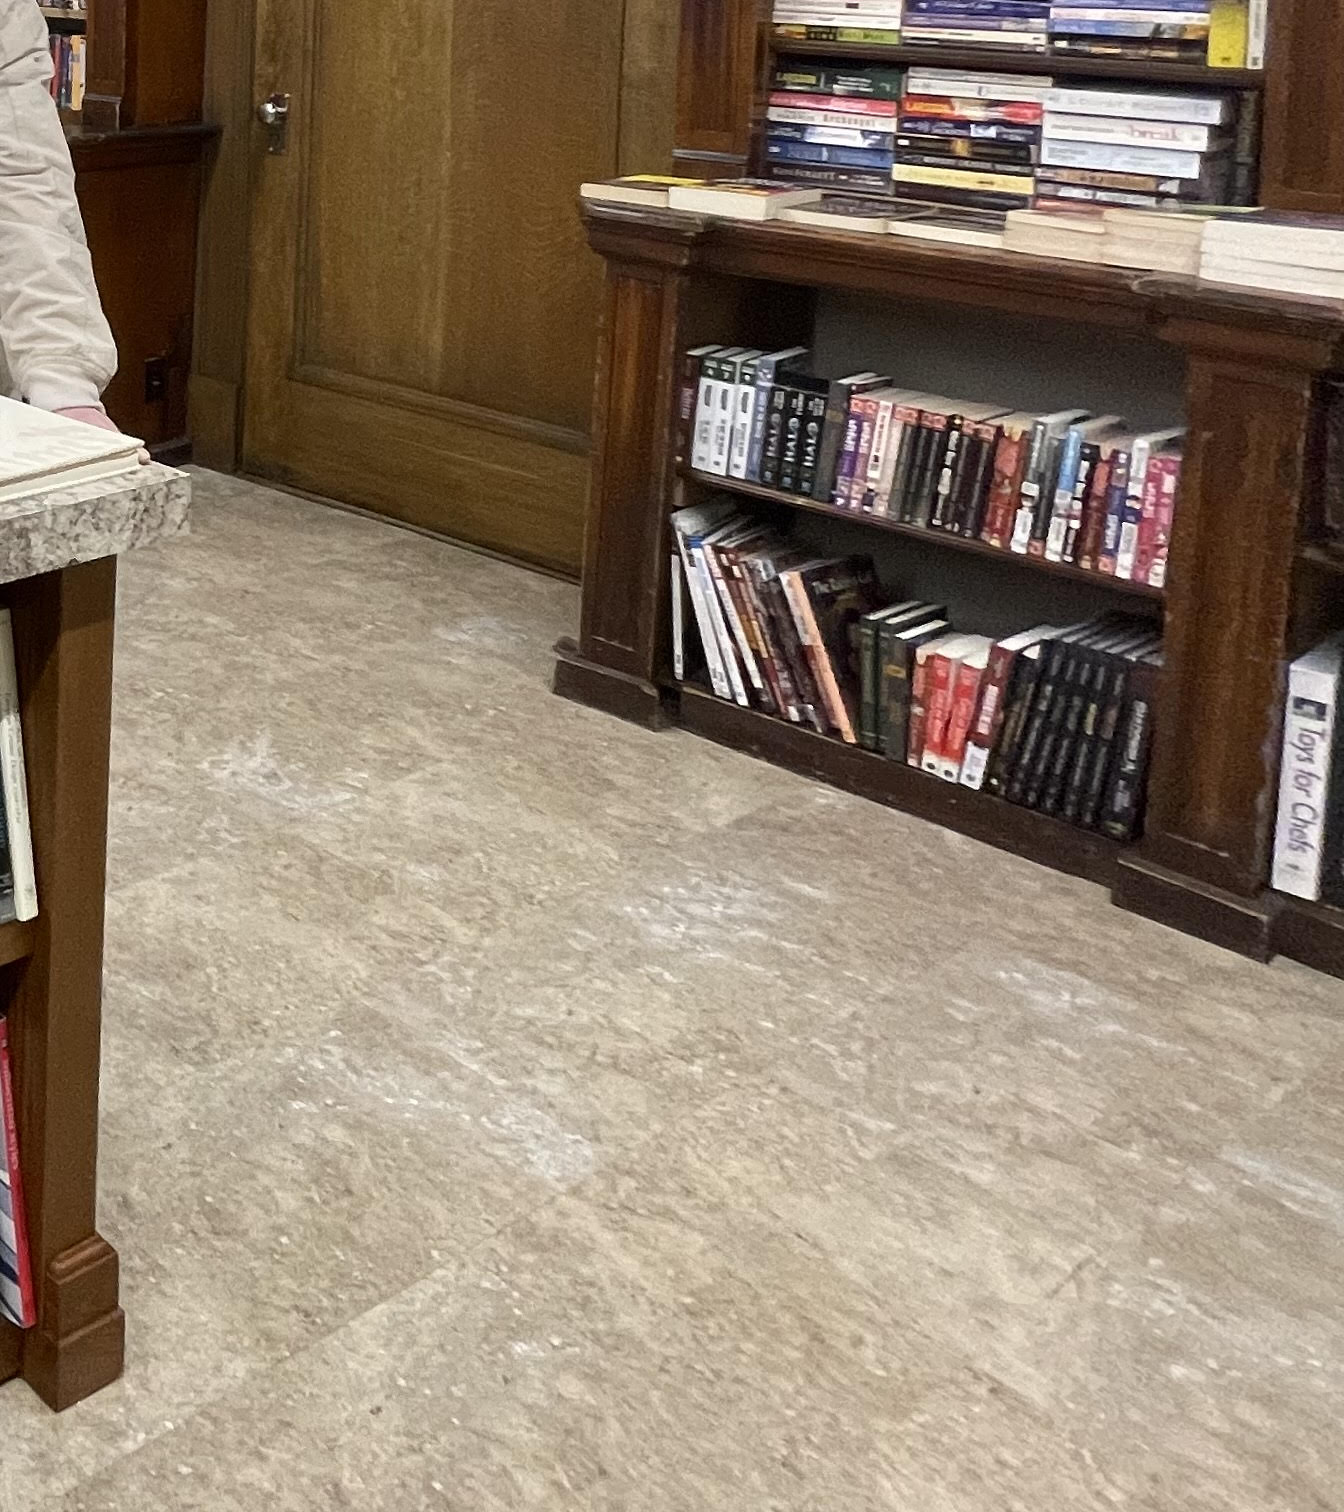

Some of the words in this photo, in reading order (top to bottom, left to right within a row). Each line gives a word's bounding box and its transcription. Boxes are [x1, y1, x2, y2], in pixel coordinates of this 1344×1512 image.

[1289, 726, 1326, 764] Toys
[1293, 769, 1323, 797] for
[1287, 802, 1320, 854] Chefs
